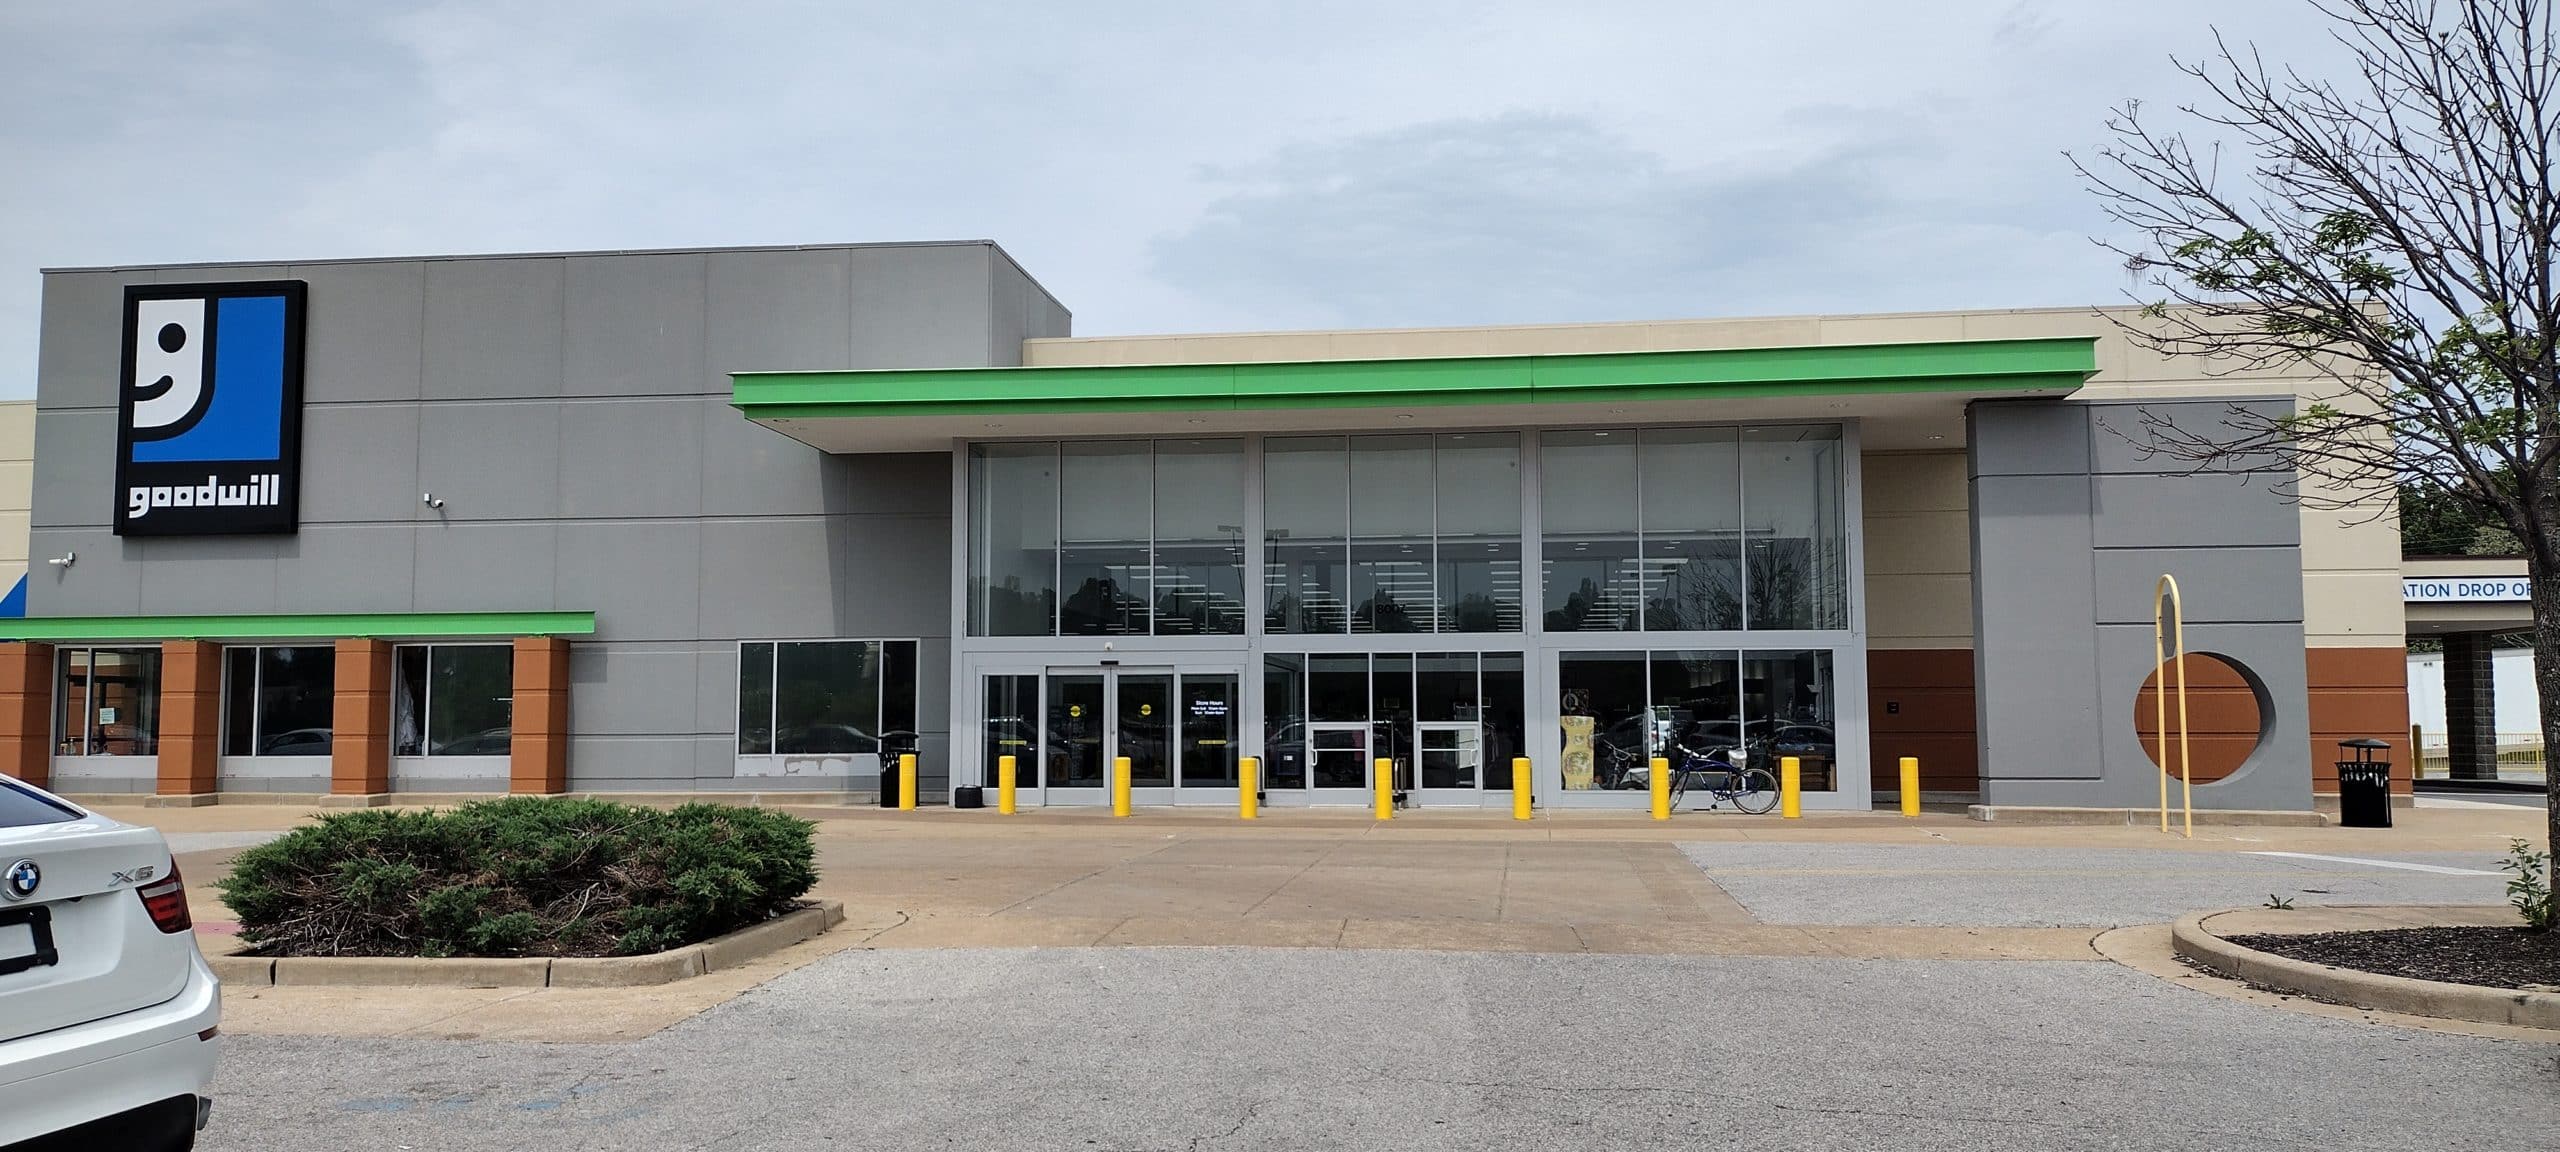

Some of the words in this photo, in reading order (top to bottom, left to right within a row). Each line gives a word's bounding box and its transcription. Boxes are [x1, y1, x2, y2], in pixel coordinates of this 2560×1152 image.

[128, 474, 280, 519] goodwill
[2458, 583, 2506, 597] DROP
[108, 865, 154, 887] X6
